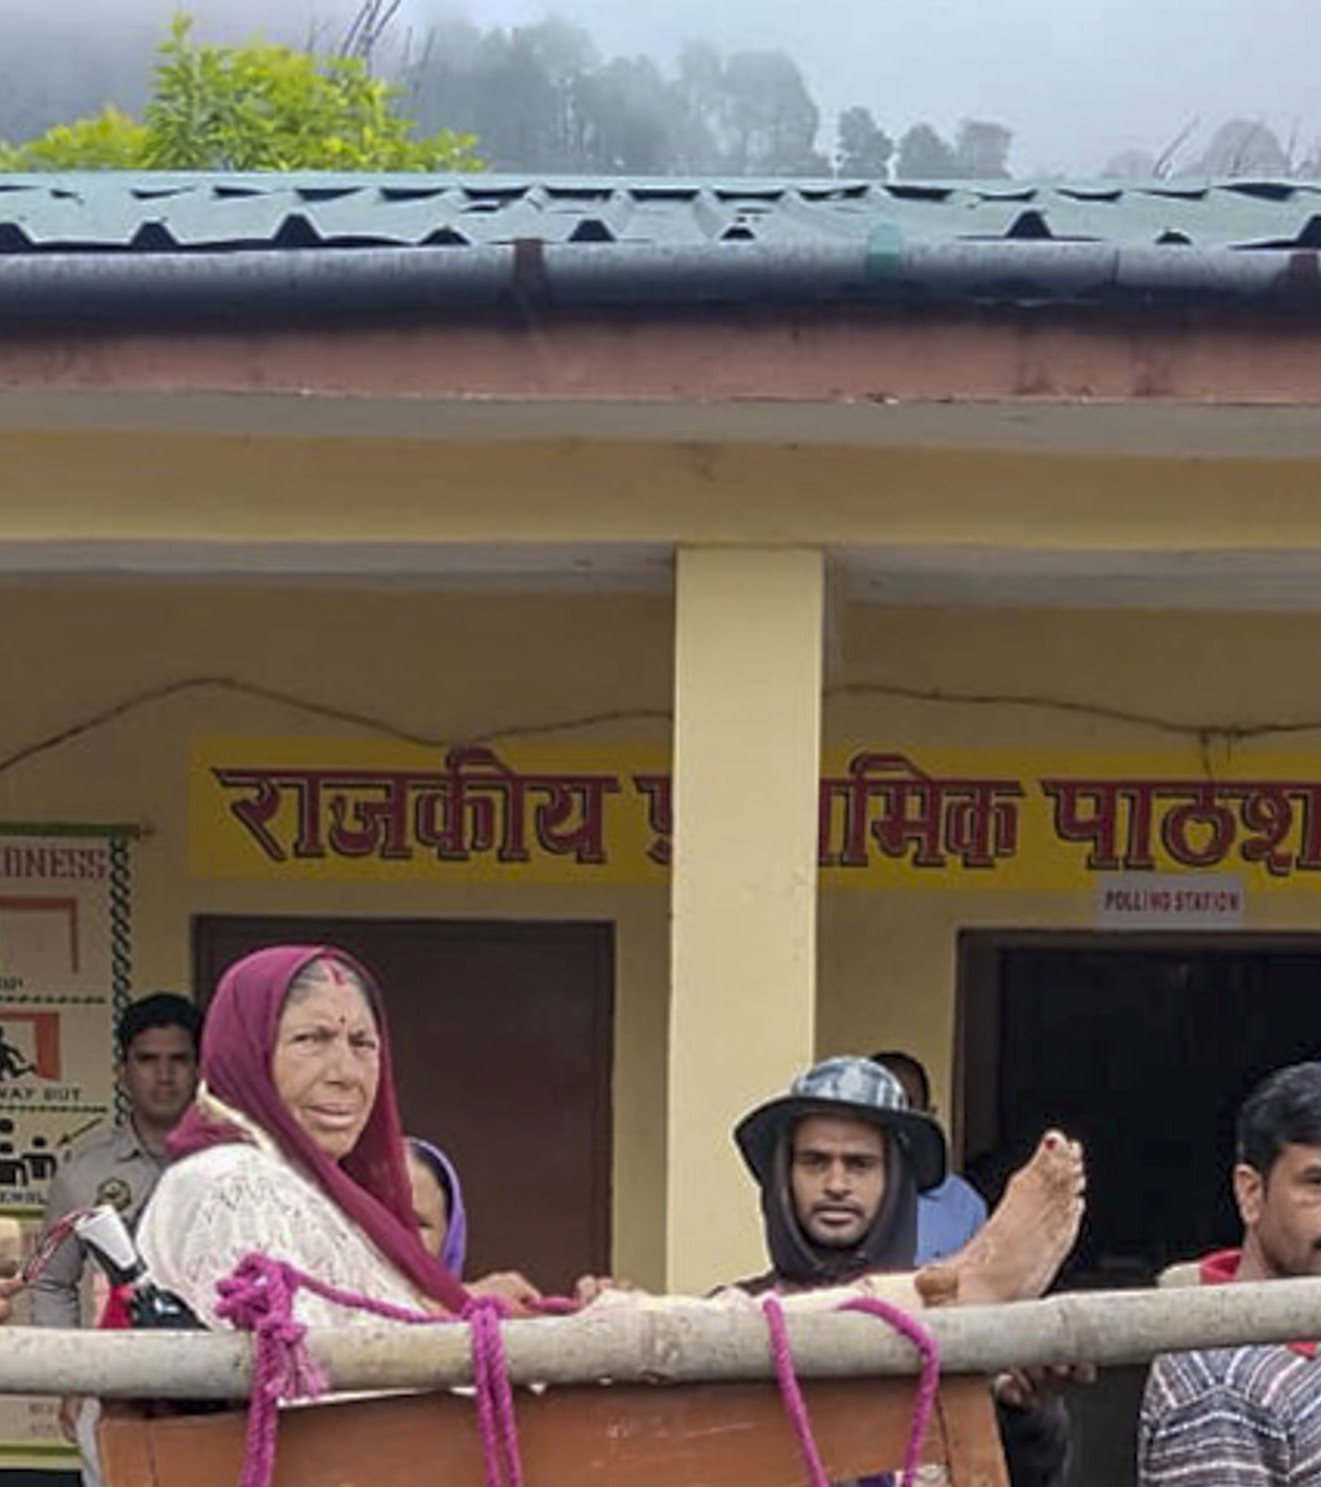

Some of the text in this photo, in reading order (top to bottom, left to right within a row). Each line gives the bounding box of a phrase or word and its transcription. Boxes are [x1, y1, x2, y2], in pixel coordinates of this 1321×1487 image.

[210, 746, 620, 864] राजकीय
[1104, 890, 1240, 912] POLLING STATION
